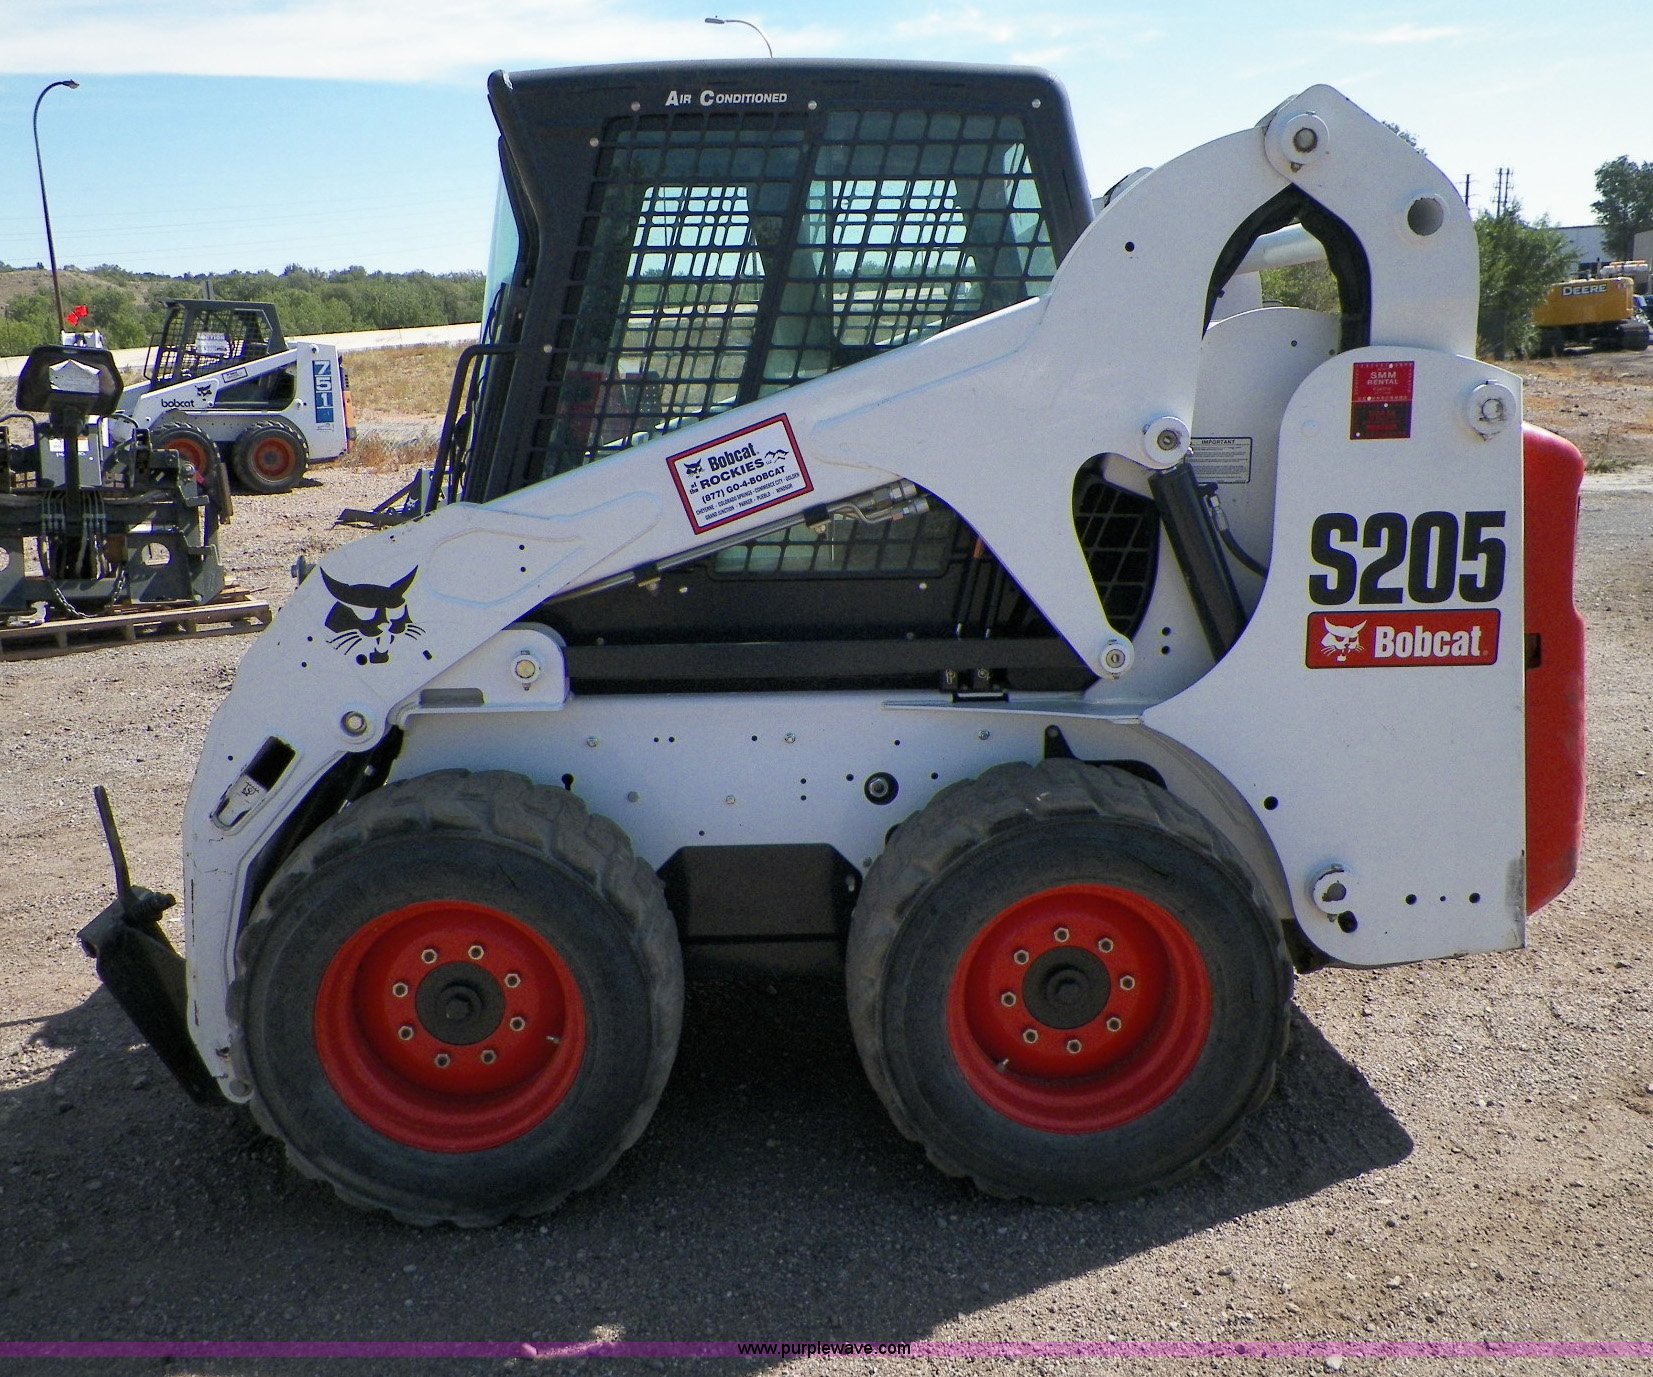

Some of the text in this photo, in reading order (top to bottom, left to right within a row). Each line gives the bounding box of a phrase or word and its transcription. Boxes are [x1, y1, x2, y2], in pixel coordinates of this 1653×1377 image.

[700, 90, 788, 106] CONDITIONED
[1562, 284, 1607, 296] DEERE
[1370, 371, 1397, 379] SMM
[161, 398, 195, 408] bobcat
[708, 443, 757, 471] Bobcat
[699, 458, 765, 489] ROCKIES
[689, 487, 699, 495] the
[702, 466, 785, 504] (877) GO-4-BOBCAT
[718, 494, 737, 507] COLORADO
[736, 490, 753, 500] SPRINGS
[1308, 510, 1506, 605] S205
[1374, 625, 1482, 658] Bobcat
